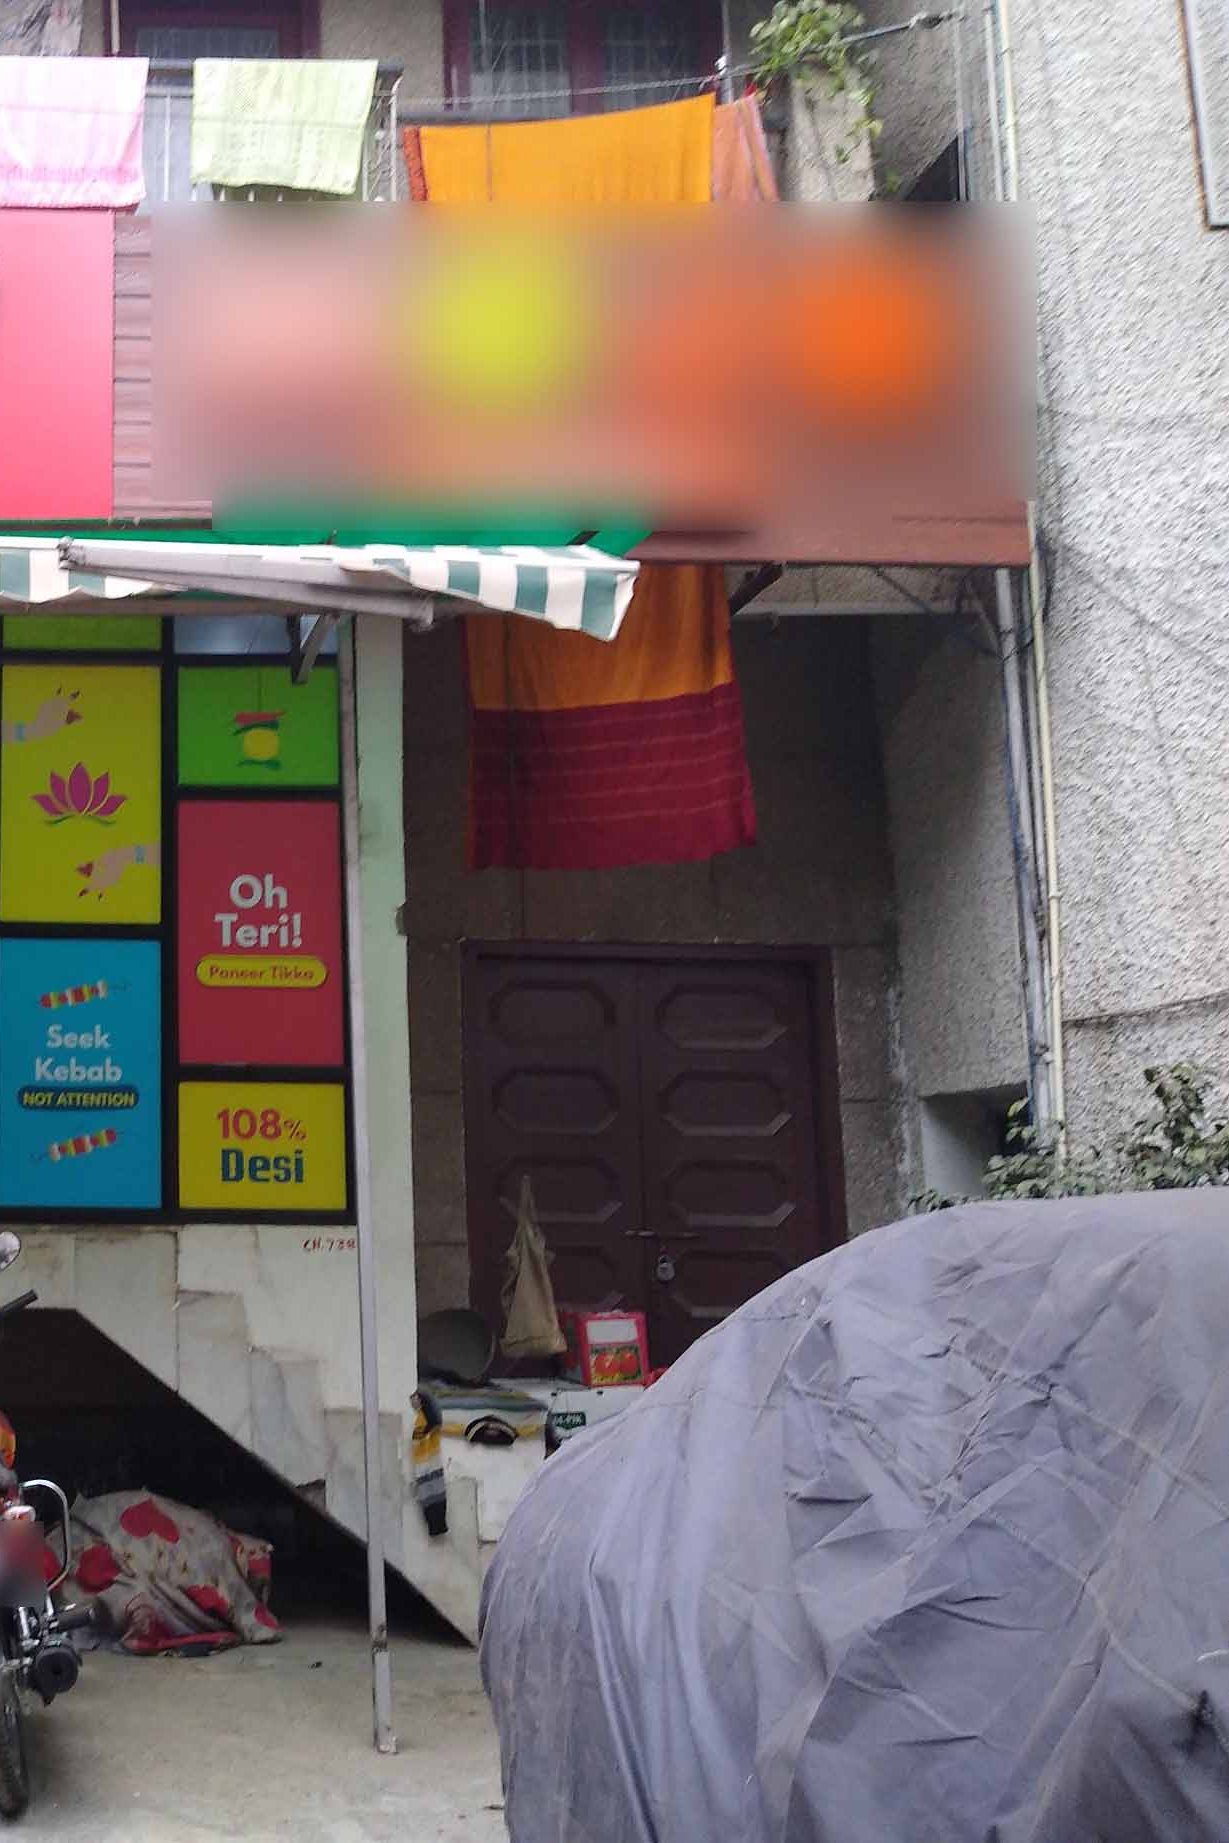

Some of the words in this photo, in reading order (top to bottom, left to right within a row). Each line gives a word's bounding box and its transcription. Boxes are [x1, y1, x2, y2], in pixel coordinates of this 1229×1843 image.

[229, 873, 288, 909] Oh
[213, 912, 302, 948] Teri!
[209, 965, 265, 979] Paneer
[270, 964, 315, 980] Tikka
[46, 1024, 111, 1049] Seek
[35, 1056, 123, 1082] Kebab
[24, 1092, 54, 1106] NOT
[56, 1092, 136, 1107] ATTENTION
[217, 1108, 307, 1141] 108%
[220, 1148, 305, 1184] Desi
